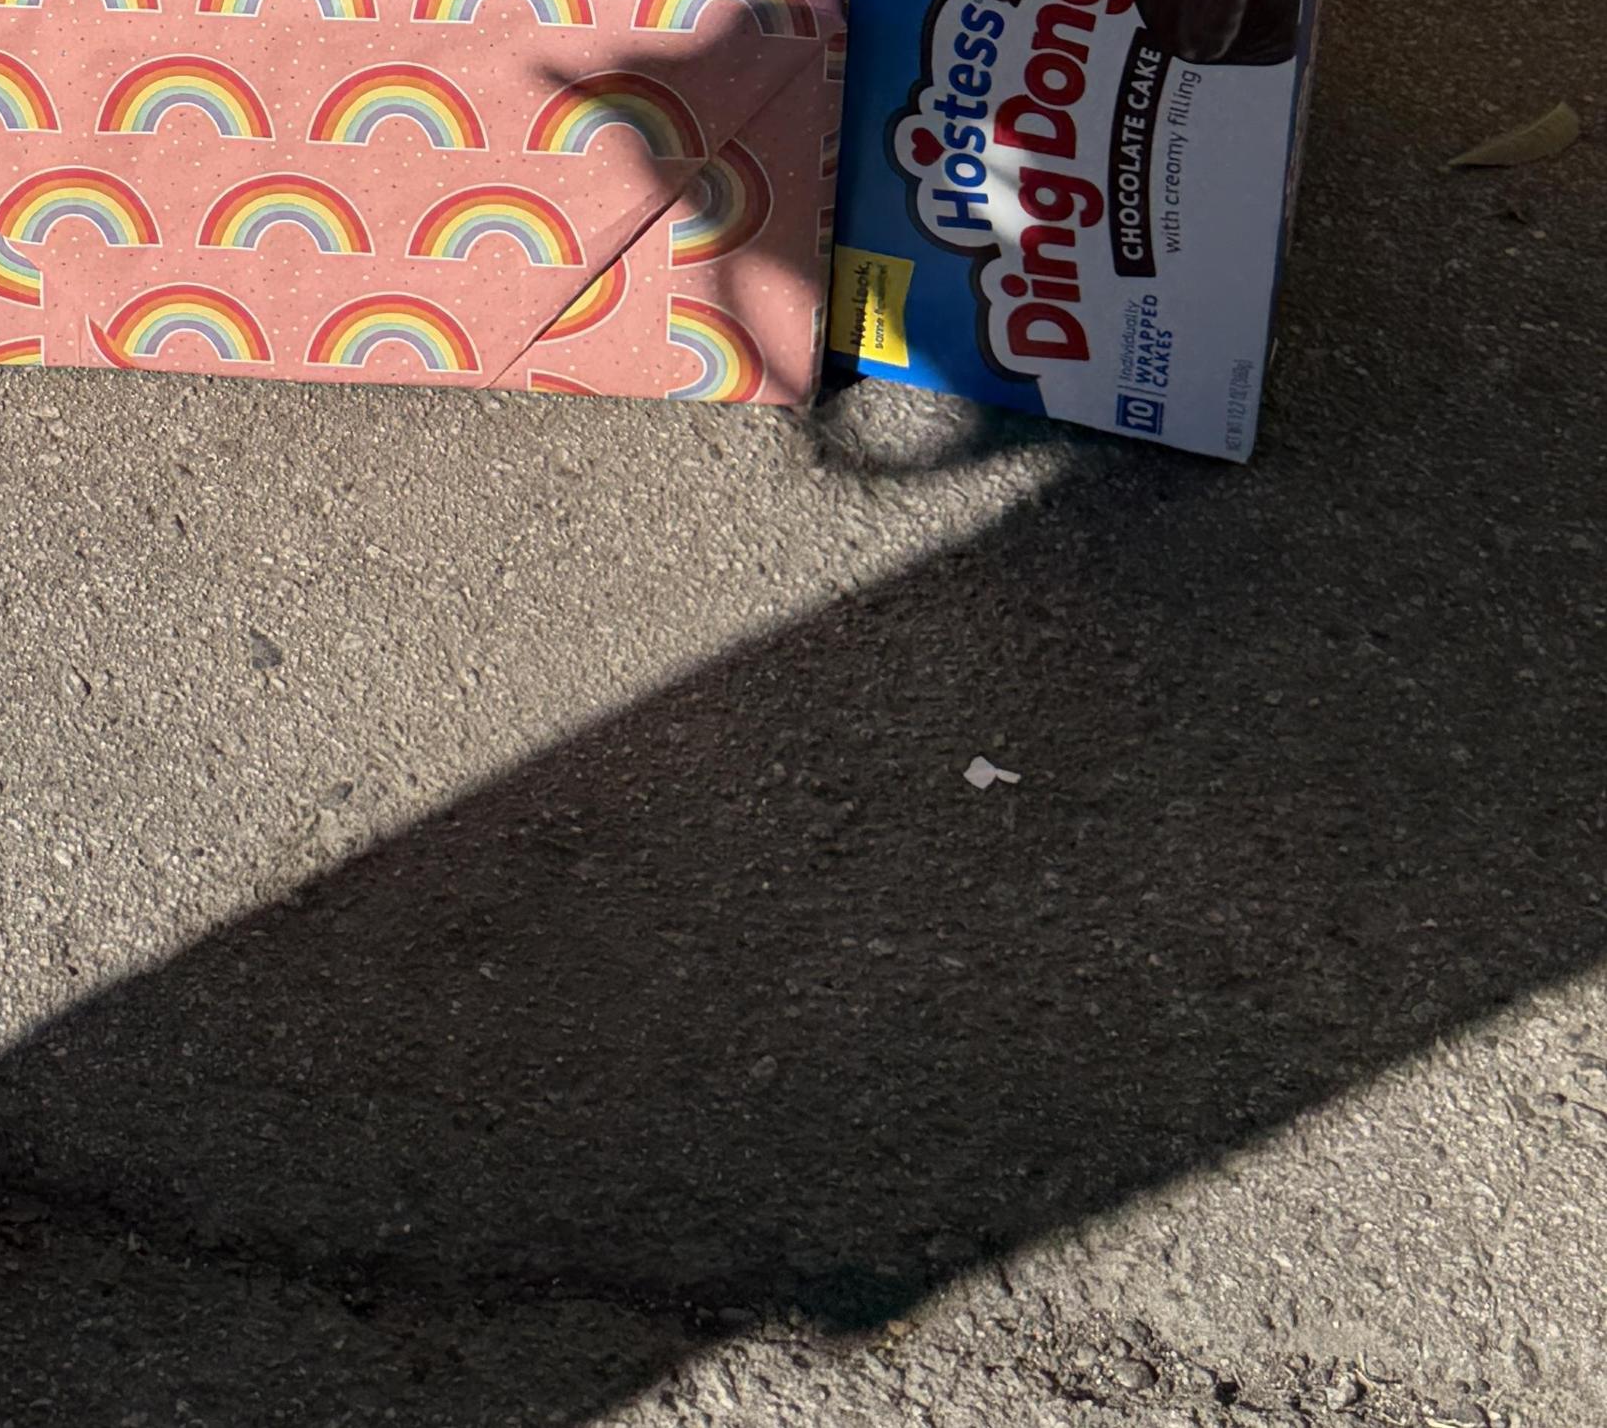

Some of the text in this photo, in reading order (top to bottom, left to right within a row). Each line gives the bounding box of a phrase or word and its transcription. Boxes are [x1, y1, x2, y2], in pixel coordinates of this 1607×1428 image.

[931, 1, 1006, 231] Hostess
[1118, 46, 1163, 261] CHOCOLATE CAKE
[1160, 69, 1202, 254] with creamy filling
[1000, 166, 1105, 361] Ding
[1135, 294, 1158, 384] WRAPPED
[1126, 400, 1155, 429] 10
[1152, 329, 1173, 388] CAKES
